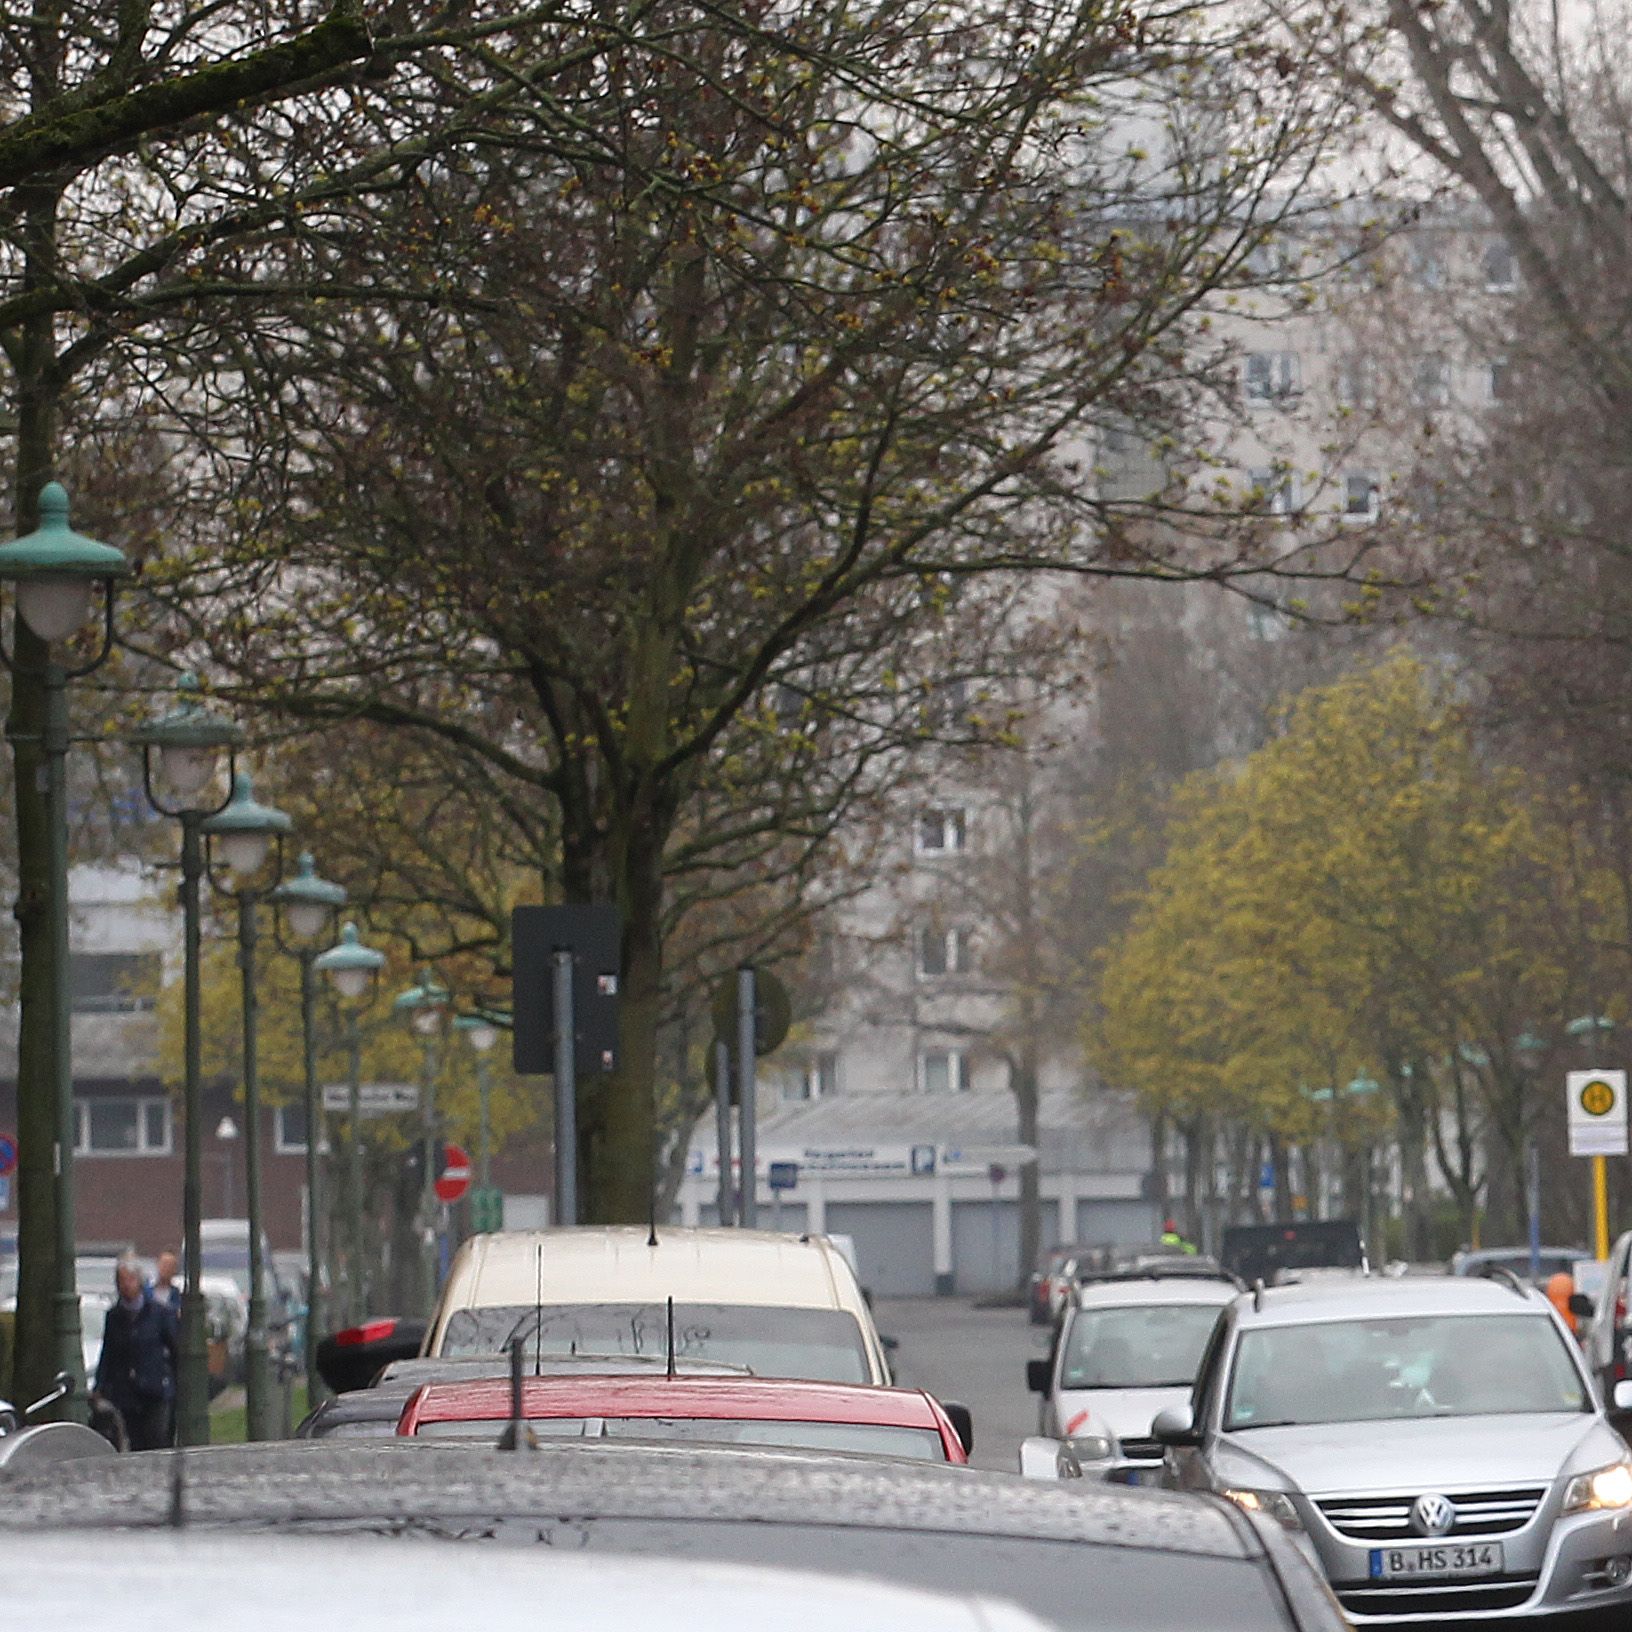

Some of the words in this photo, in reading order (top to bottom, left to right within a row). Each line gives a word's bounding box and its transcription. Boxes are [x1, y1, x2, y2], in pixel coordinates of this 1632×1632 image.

[1389, 1551, 1404, 1572] B
[1418, 1550, 1447, 1570] HS
[1453, 1546, 1492, 1569] 314
